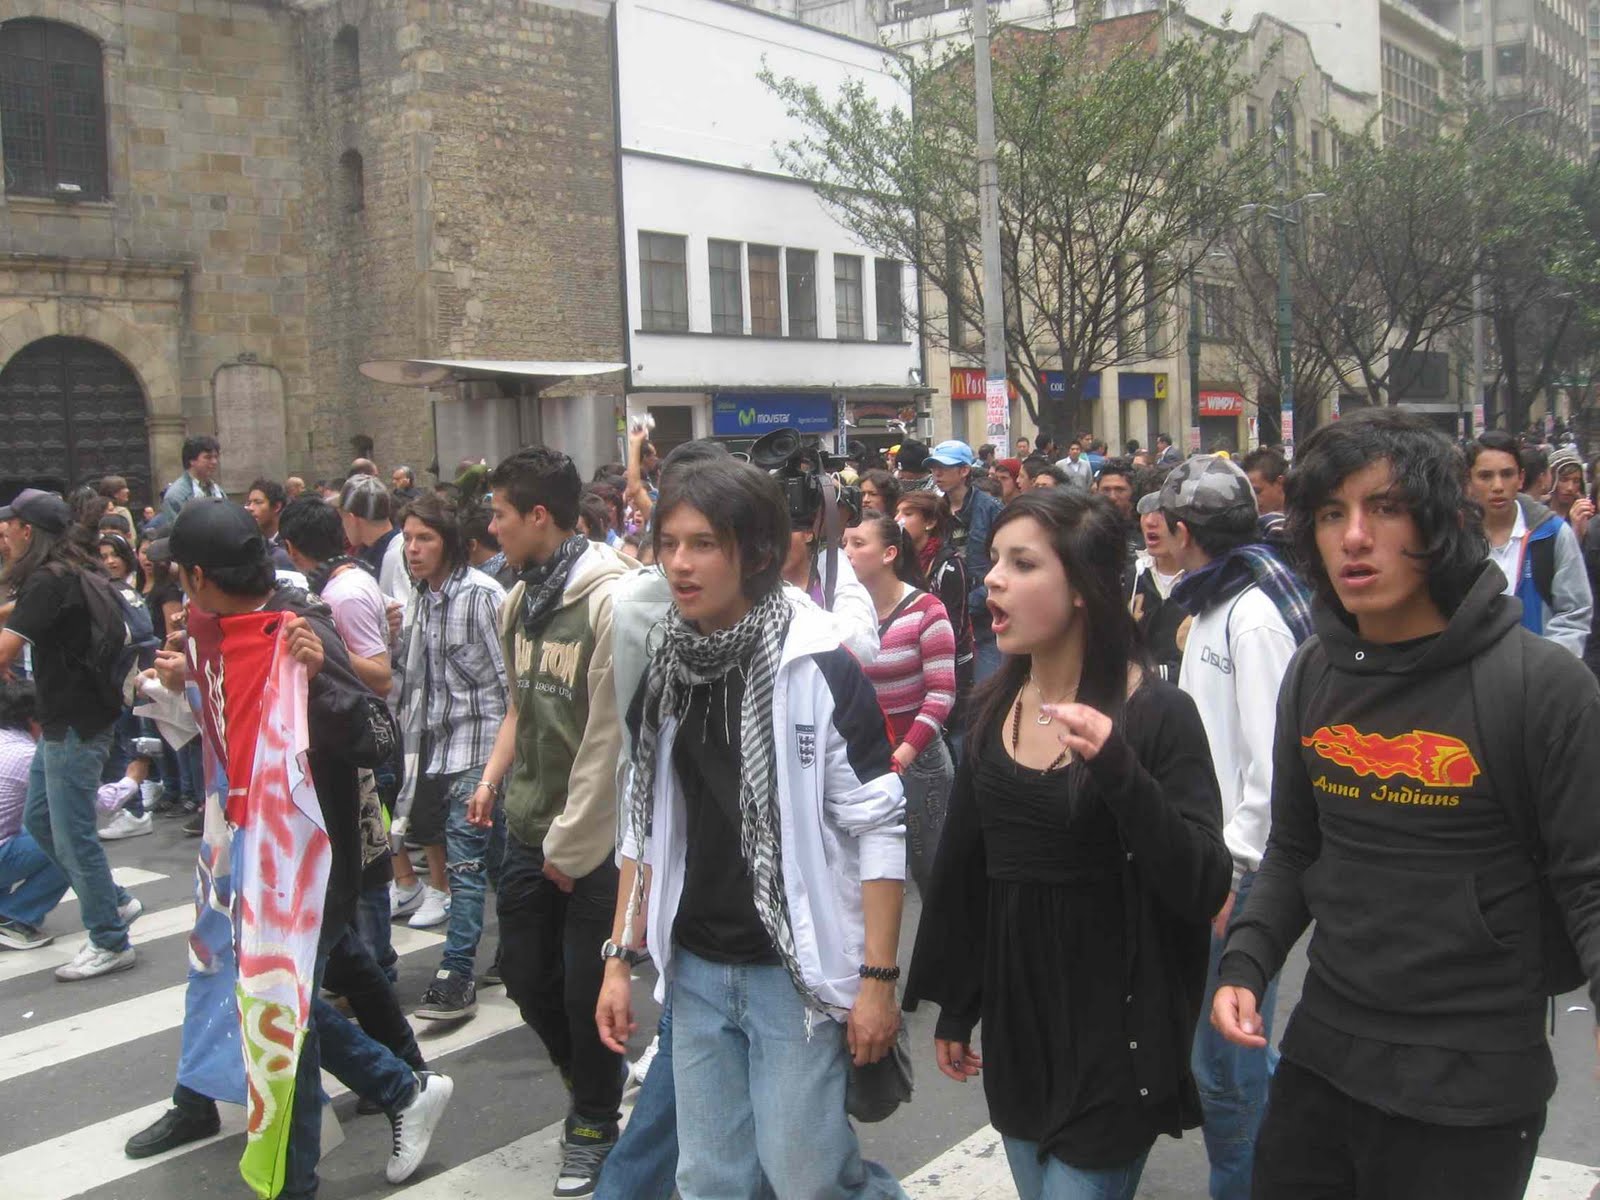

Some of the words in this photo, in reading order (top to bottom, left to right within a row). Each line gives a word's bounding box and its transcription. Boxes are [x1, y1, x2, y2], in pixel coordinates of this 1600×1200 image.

[1207, 396, 1235, 410] WIMPY
[757, 413, 791, 424] movistar
[1312, 776, 1360, 799] Anna
[1371, 785, 1460, 806] Indians
